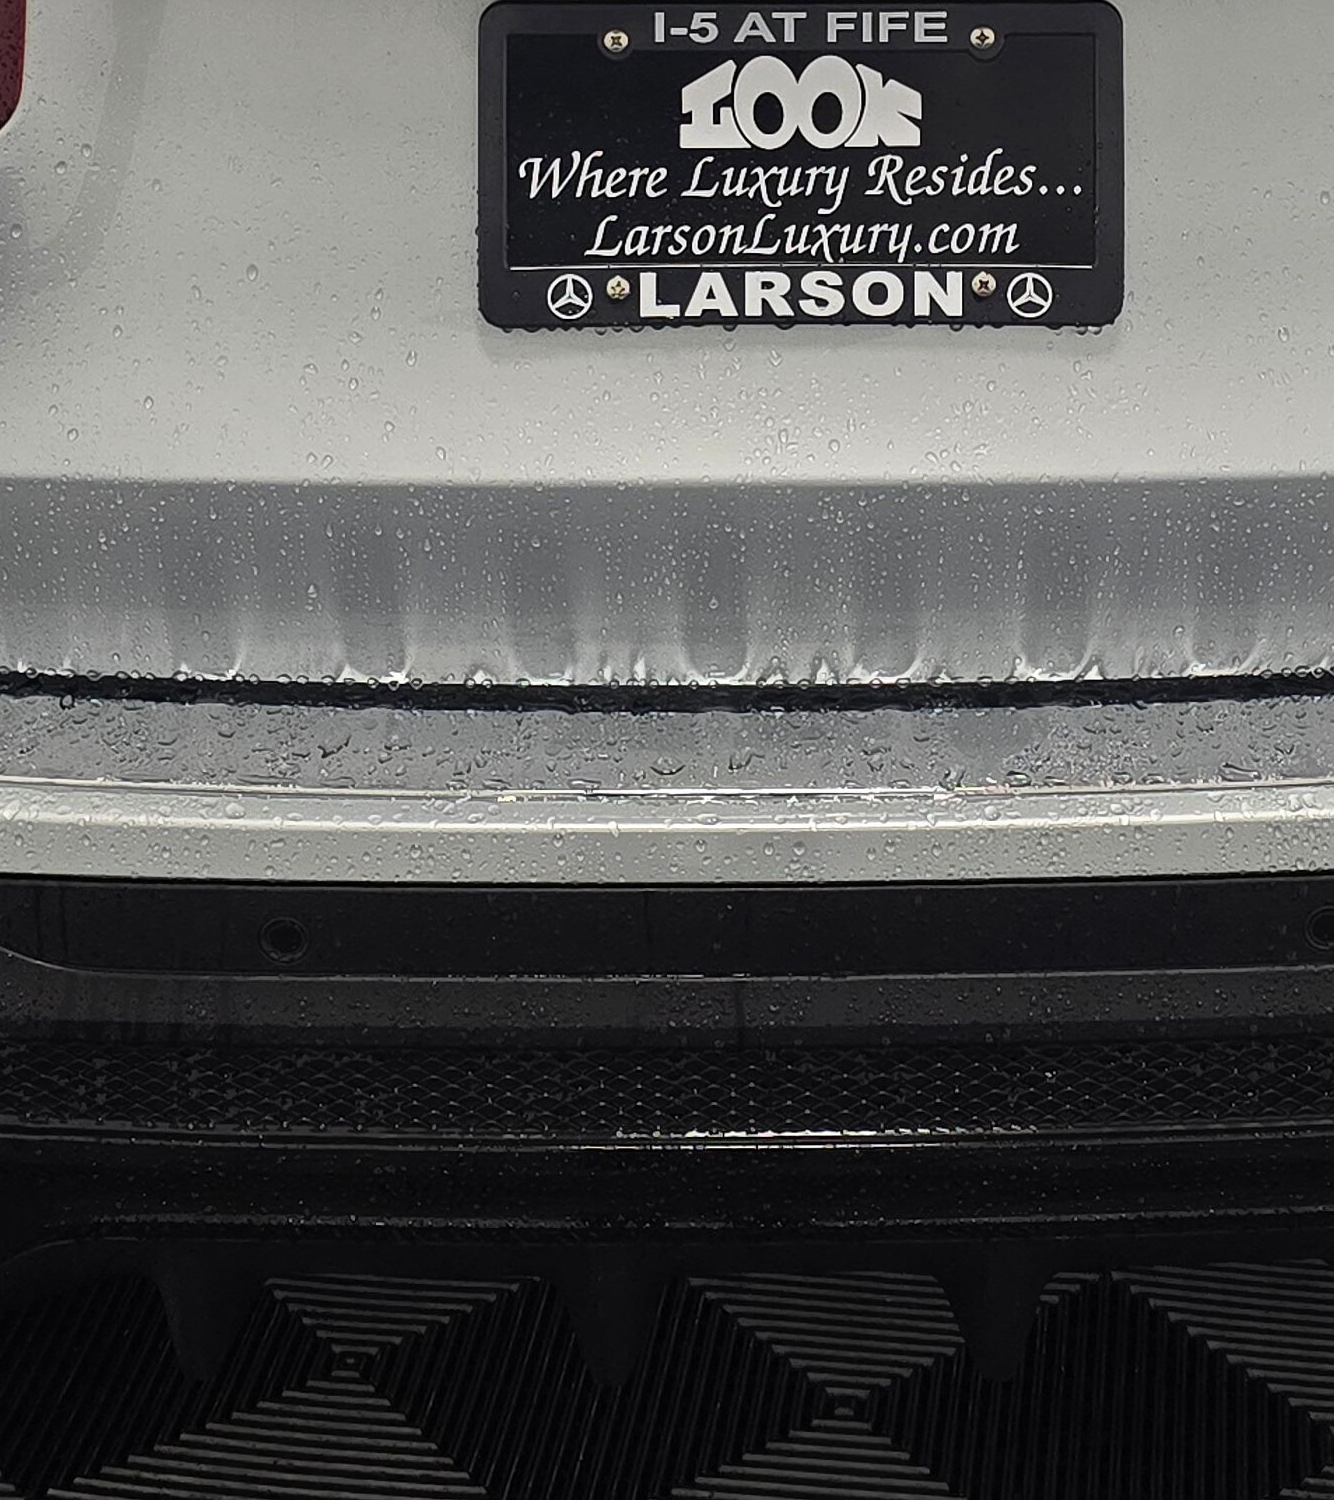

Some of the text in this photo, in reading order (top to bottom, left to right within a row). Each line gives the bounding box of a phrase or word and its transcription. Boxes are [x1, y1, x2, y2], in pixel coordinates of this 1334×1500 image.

[654, 10, 949, 44] I-5 AT FIFE
[679, 55, 923, 150] LOOK
[518, 147, 1083, 214] Where Luxury Resides...
[583, 213, 1020, 263] LarsonLuxury.com
[639, 270, 963, 320] LARSON
